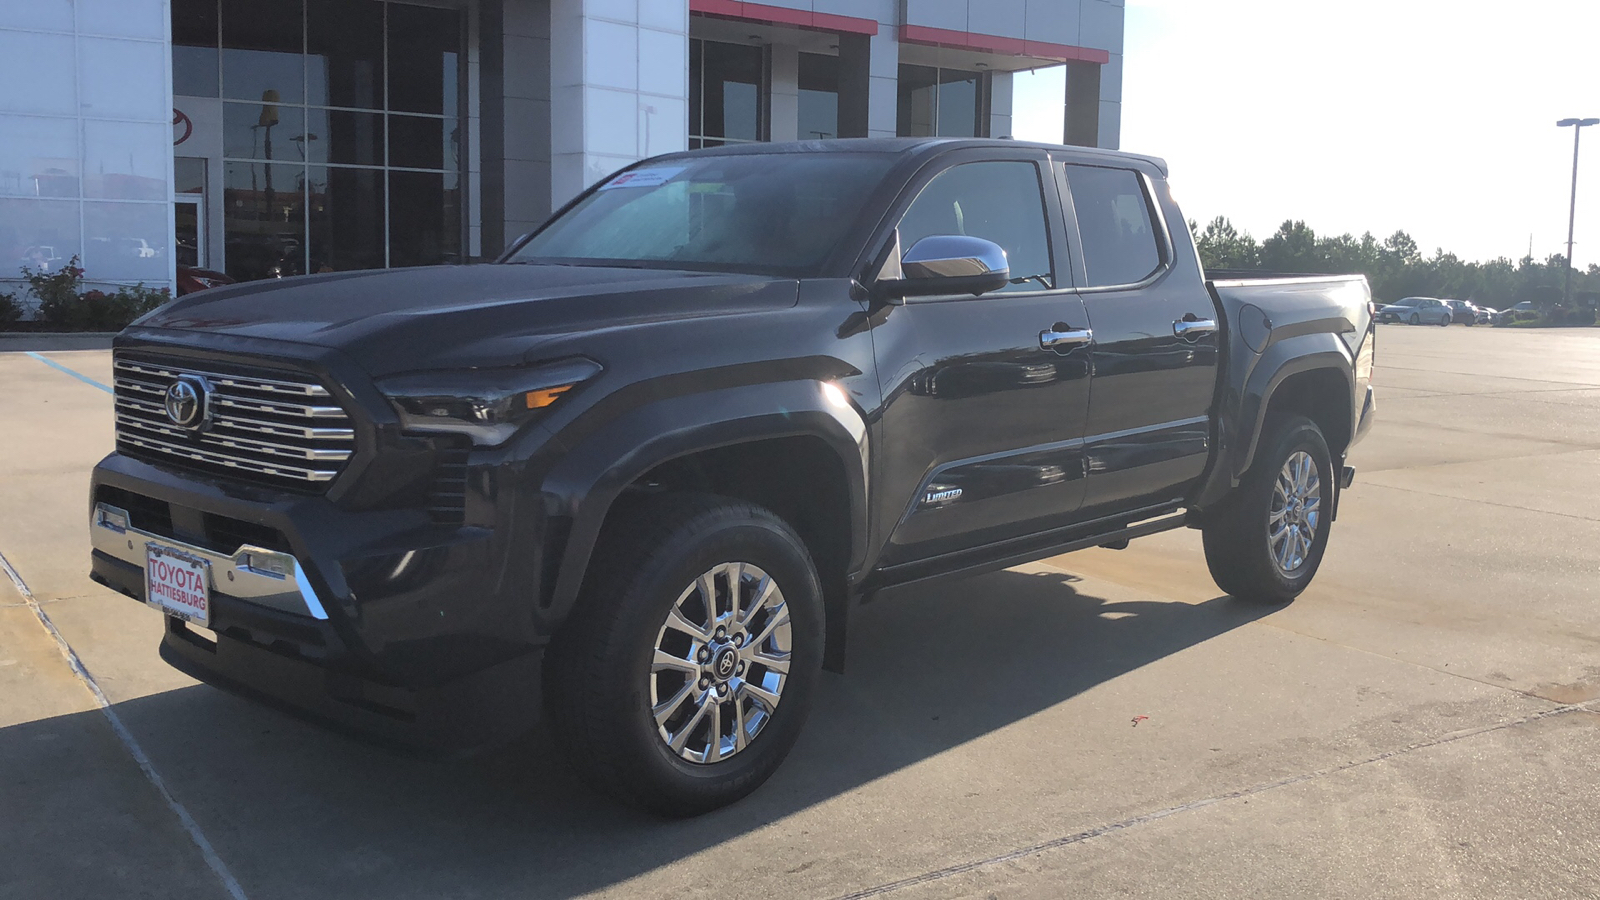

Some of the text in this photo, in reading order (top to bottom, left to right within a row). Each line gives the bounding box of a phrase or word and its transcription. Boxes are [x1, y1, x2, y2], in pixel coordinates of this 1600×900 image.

[926, 488, 963, 503] LIMITED
[150, 558, 204, 594] TOYOTA
[151, 580, 206, 610] HATTIESBURG
